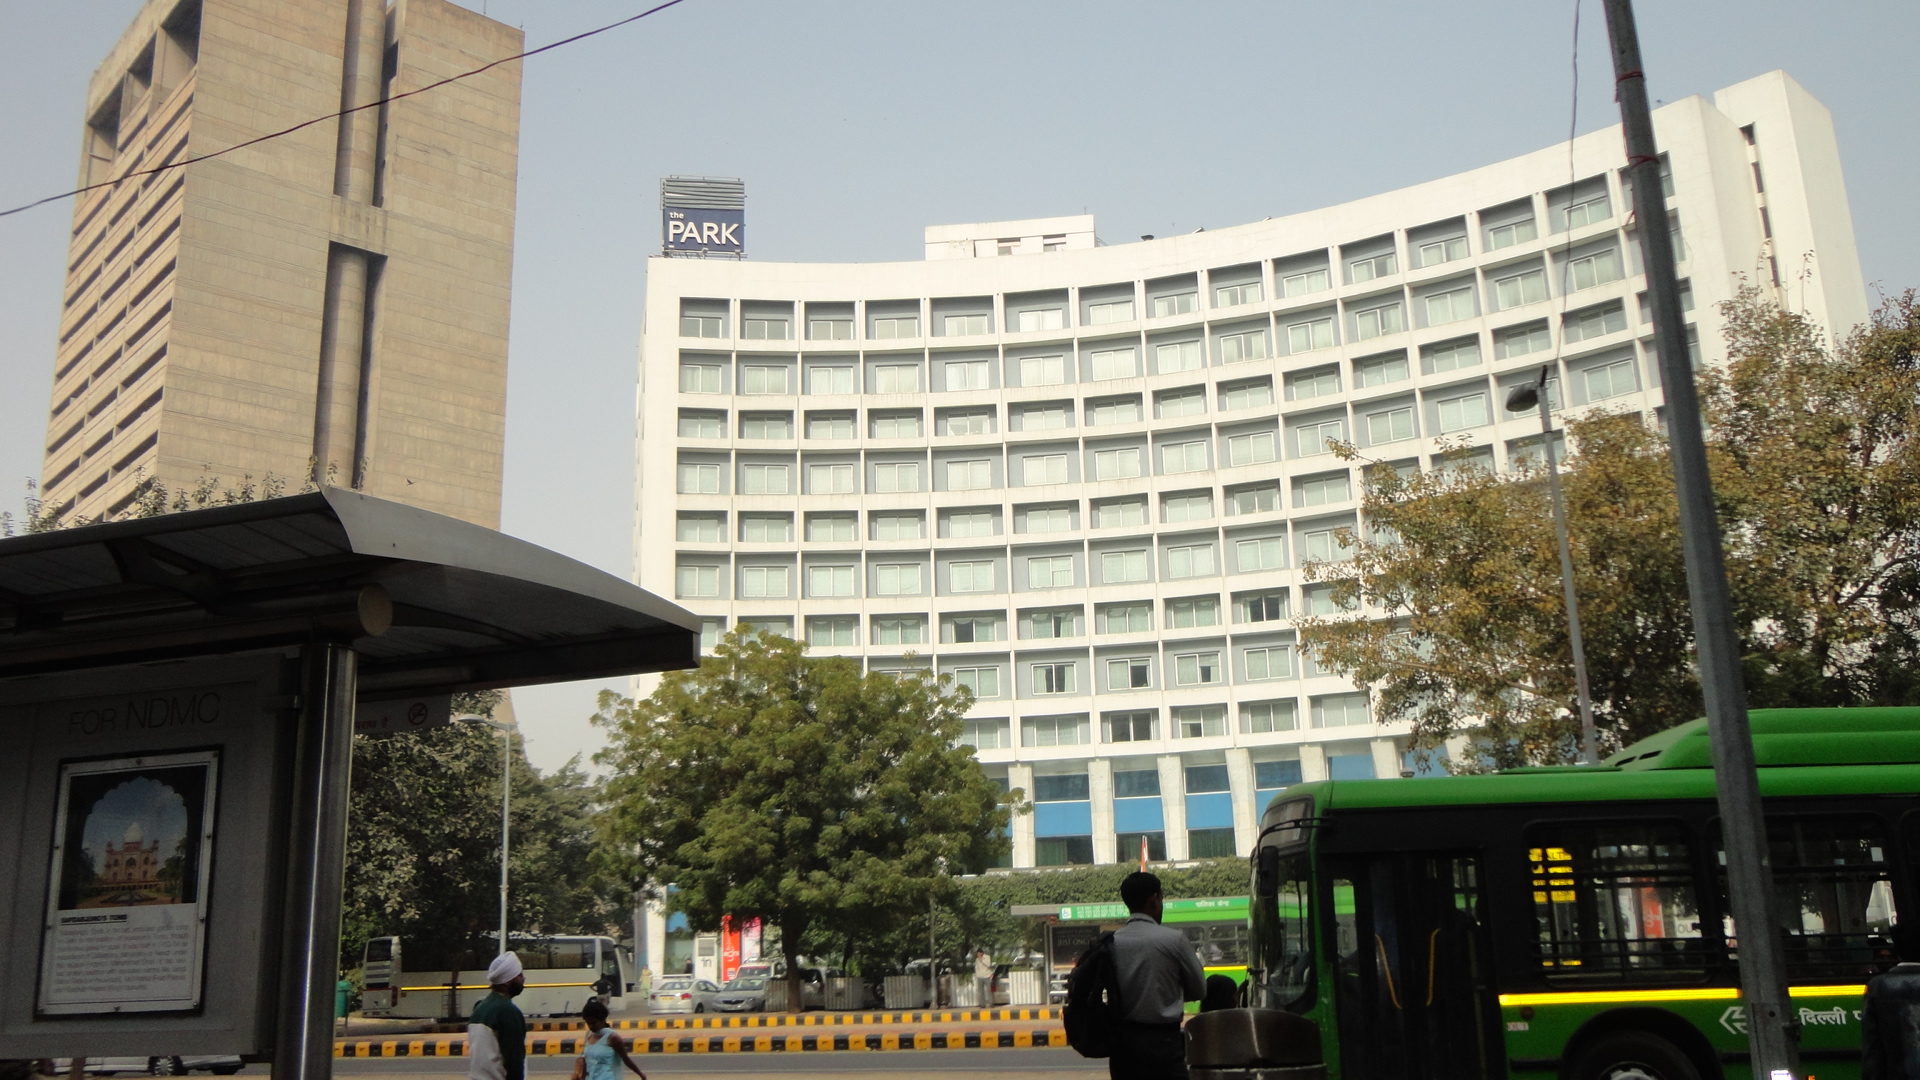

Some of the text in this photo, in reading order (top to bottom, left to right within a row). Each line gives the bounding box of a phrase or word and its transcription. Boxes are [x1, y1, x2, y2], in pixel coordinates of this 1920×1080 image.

[669, 211, 684, 219] the
[668, 220, 740, 245] PARK
[69, 693, 220, 735] FOR NDMC
[1798, 1006, 1847, 1026] दिल्ली
